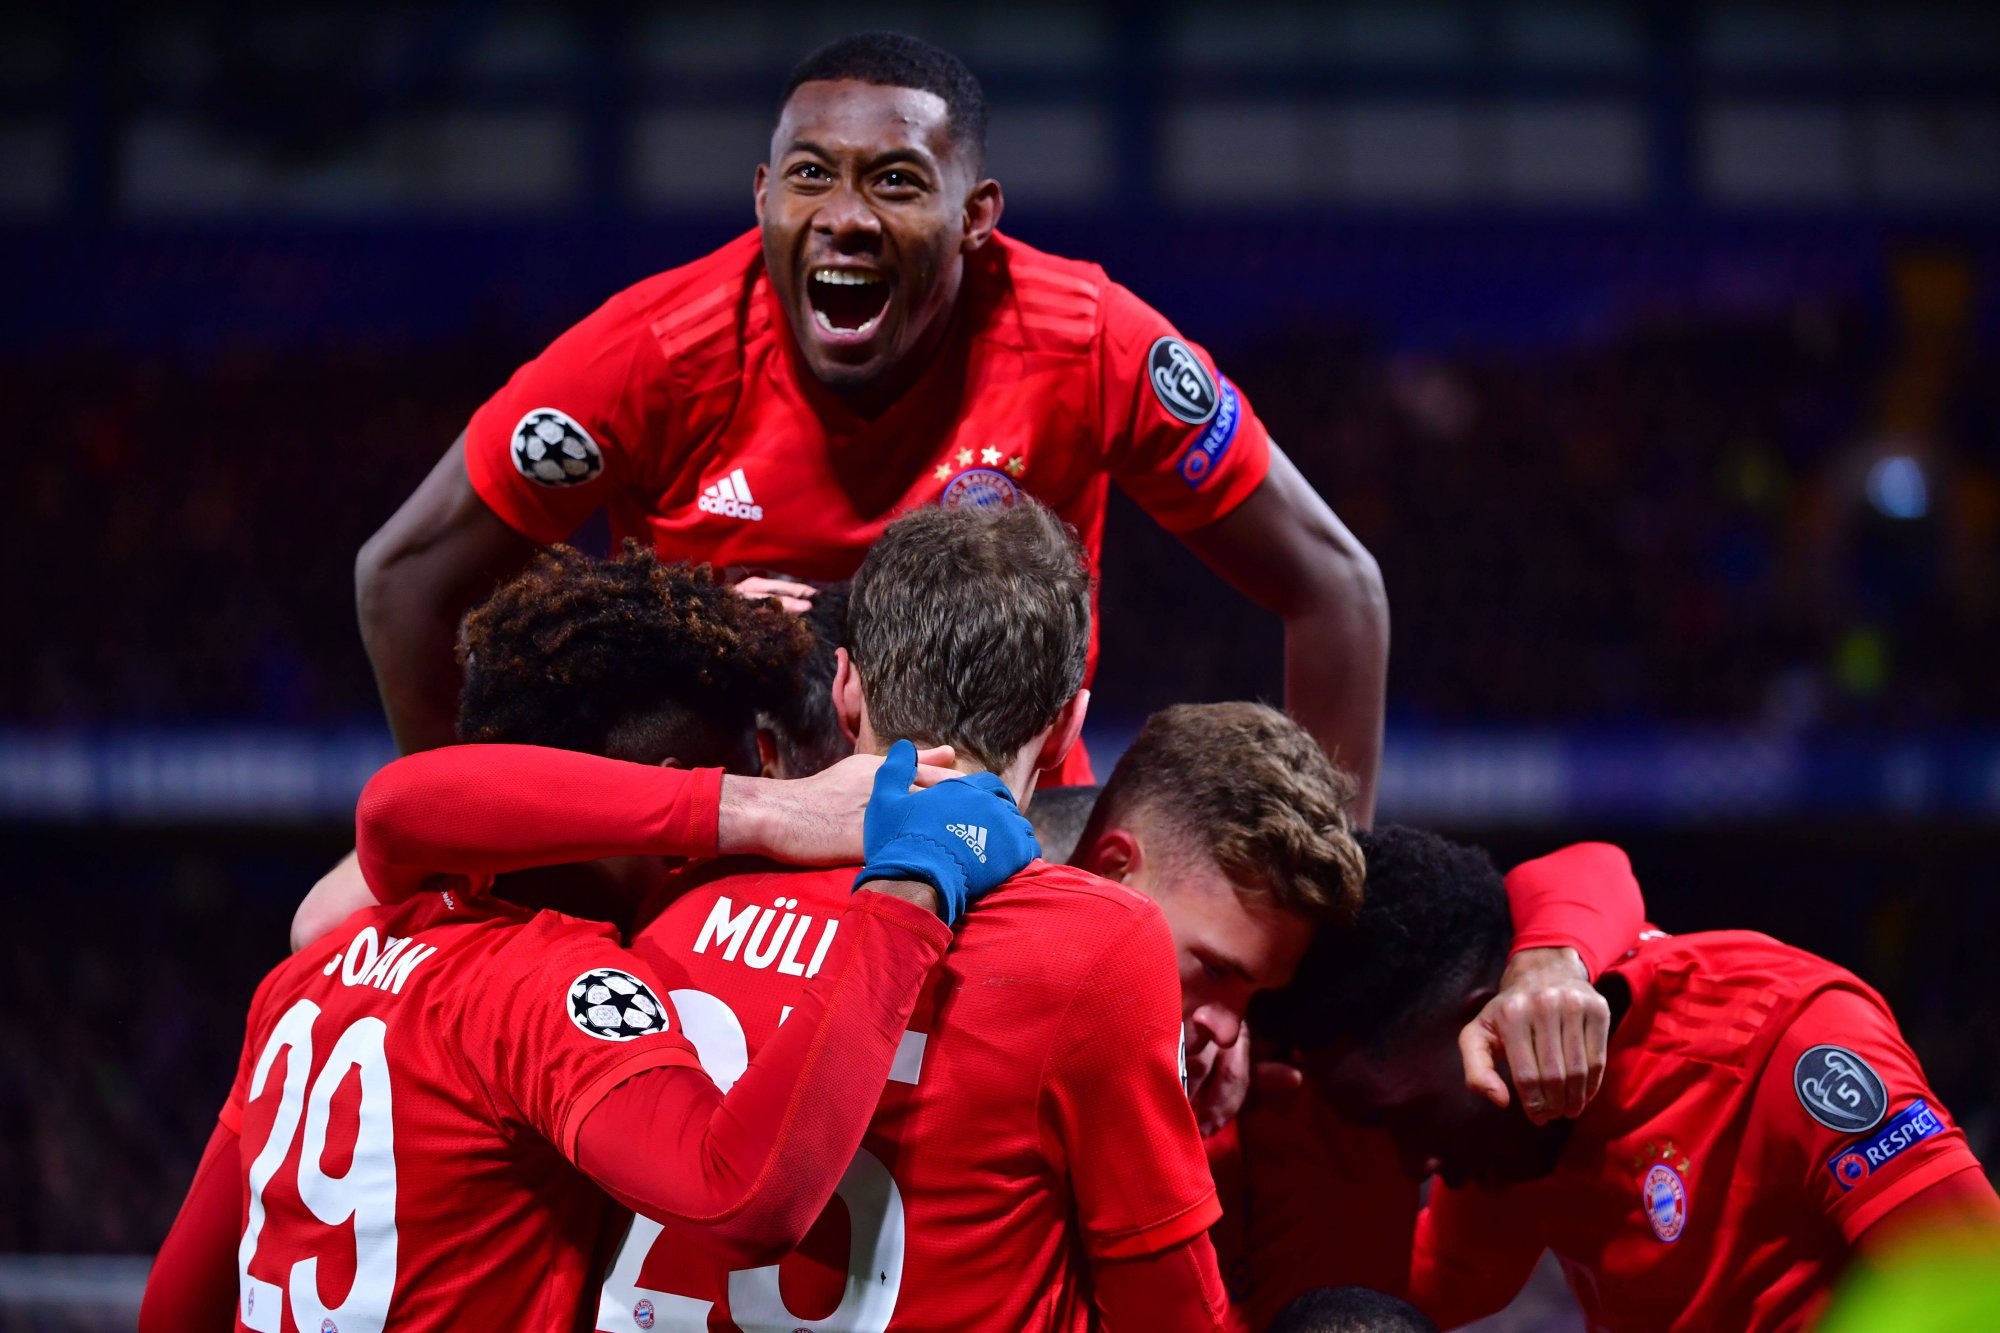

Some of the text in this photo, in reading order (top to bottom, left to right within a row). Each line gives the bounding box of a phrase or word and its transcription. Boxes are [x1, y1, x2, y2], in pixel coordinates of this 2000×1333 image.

[1180, 374, 1201, 401] 5
[946, 824, 987, 864] adidas
[1836, 1081, 1861, 1108] 5
[1866, 1108, 1937, 1166] RESPECT
[238, 998, 398, 1333] 29
